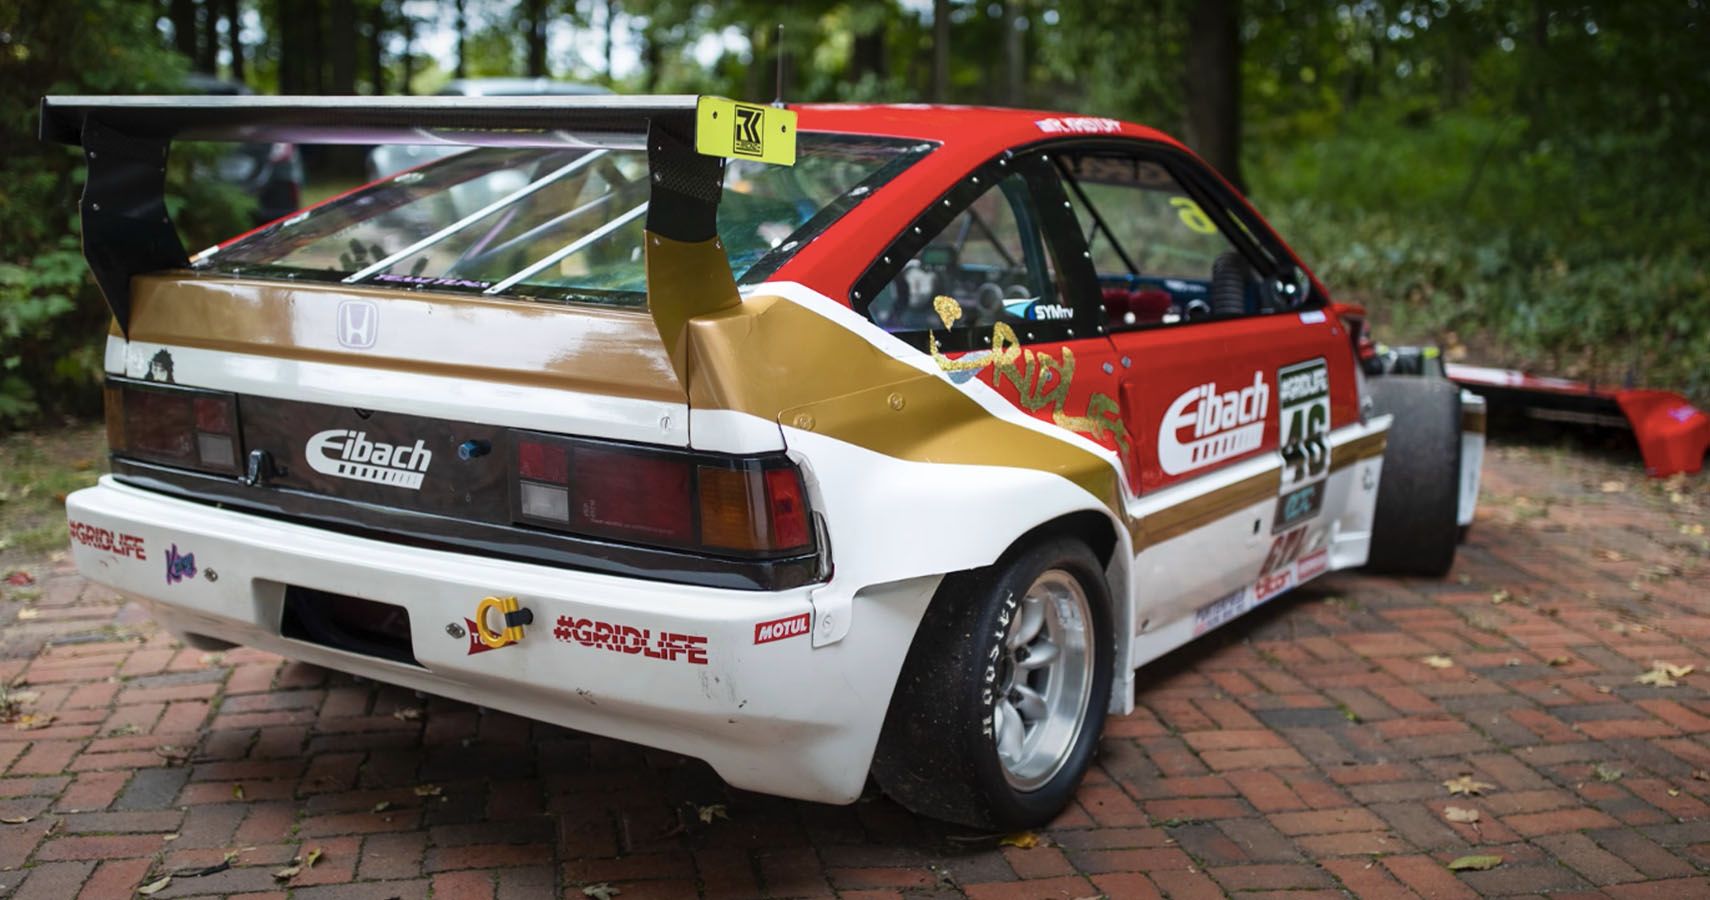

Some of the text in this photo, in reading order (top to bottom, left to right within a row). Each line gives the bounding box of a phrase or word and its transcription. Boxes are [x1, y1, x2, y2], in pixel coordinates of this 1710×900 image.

[1158, 370, 1270, 476] Eibach
[1281, 402, 1327, 484] 46
[305, 429, 432, 490] Eibach
[69, 520, 147, 561] #GRIDLIFE
[553, 615, 709, 665] #GRIDLIFE
[758, 617, 809, 642] MOTUL
